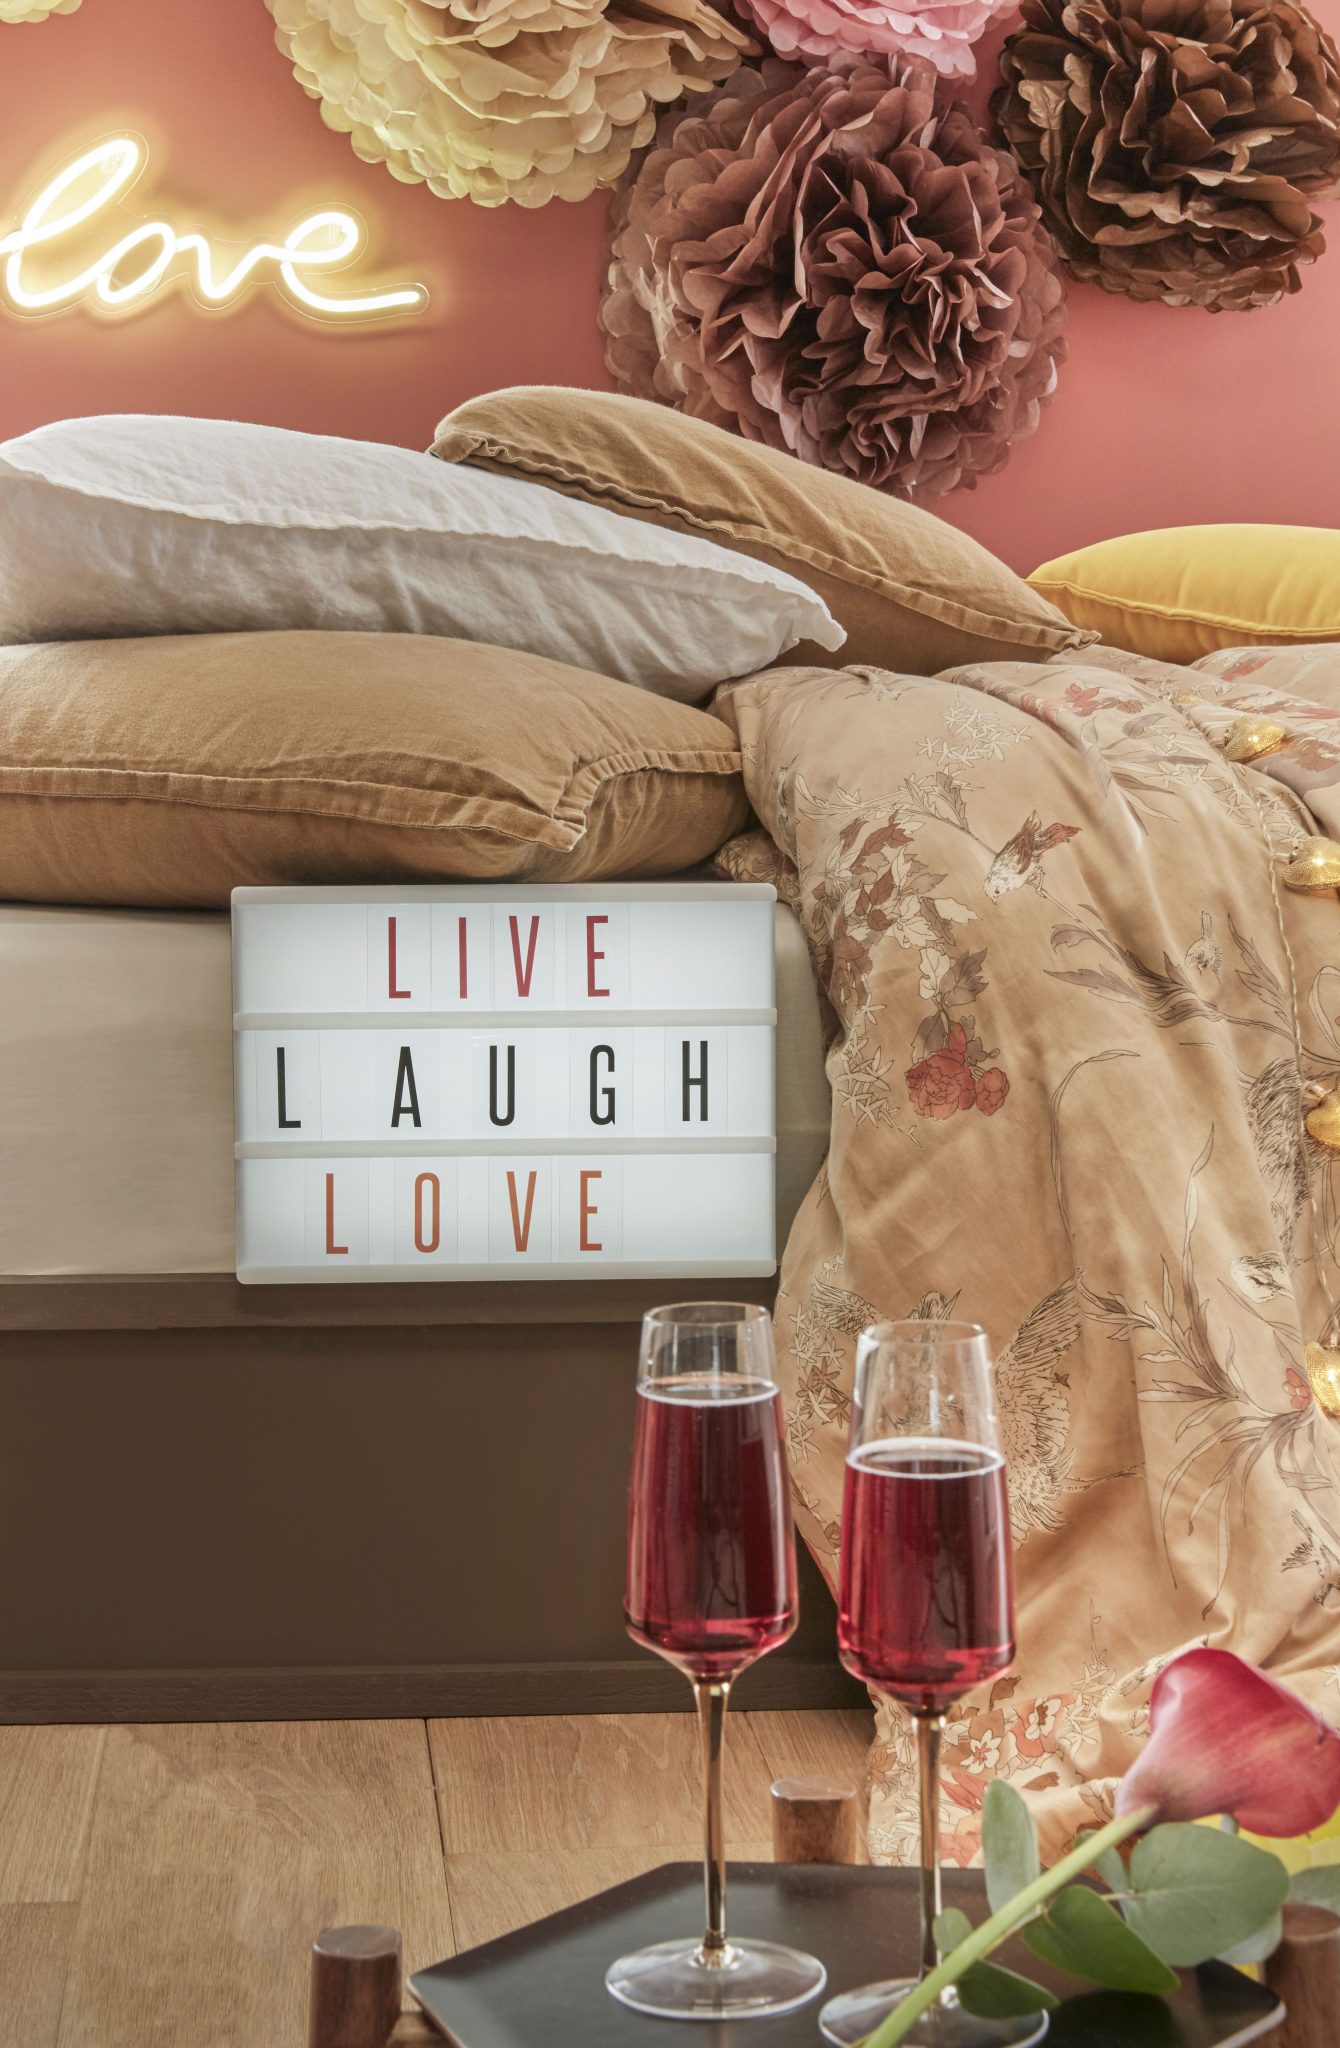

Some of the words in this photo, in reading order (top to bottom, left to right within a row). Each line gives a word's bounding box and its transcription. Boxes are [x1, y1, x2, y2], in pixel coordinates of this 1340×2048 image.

[0, 138, 420, 313] love
[387, 915, 611, 999] LIVE
[275, 1040, 709, 1129] LAUGH
[325, 1170, 603, 1255] LOVE
